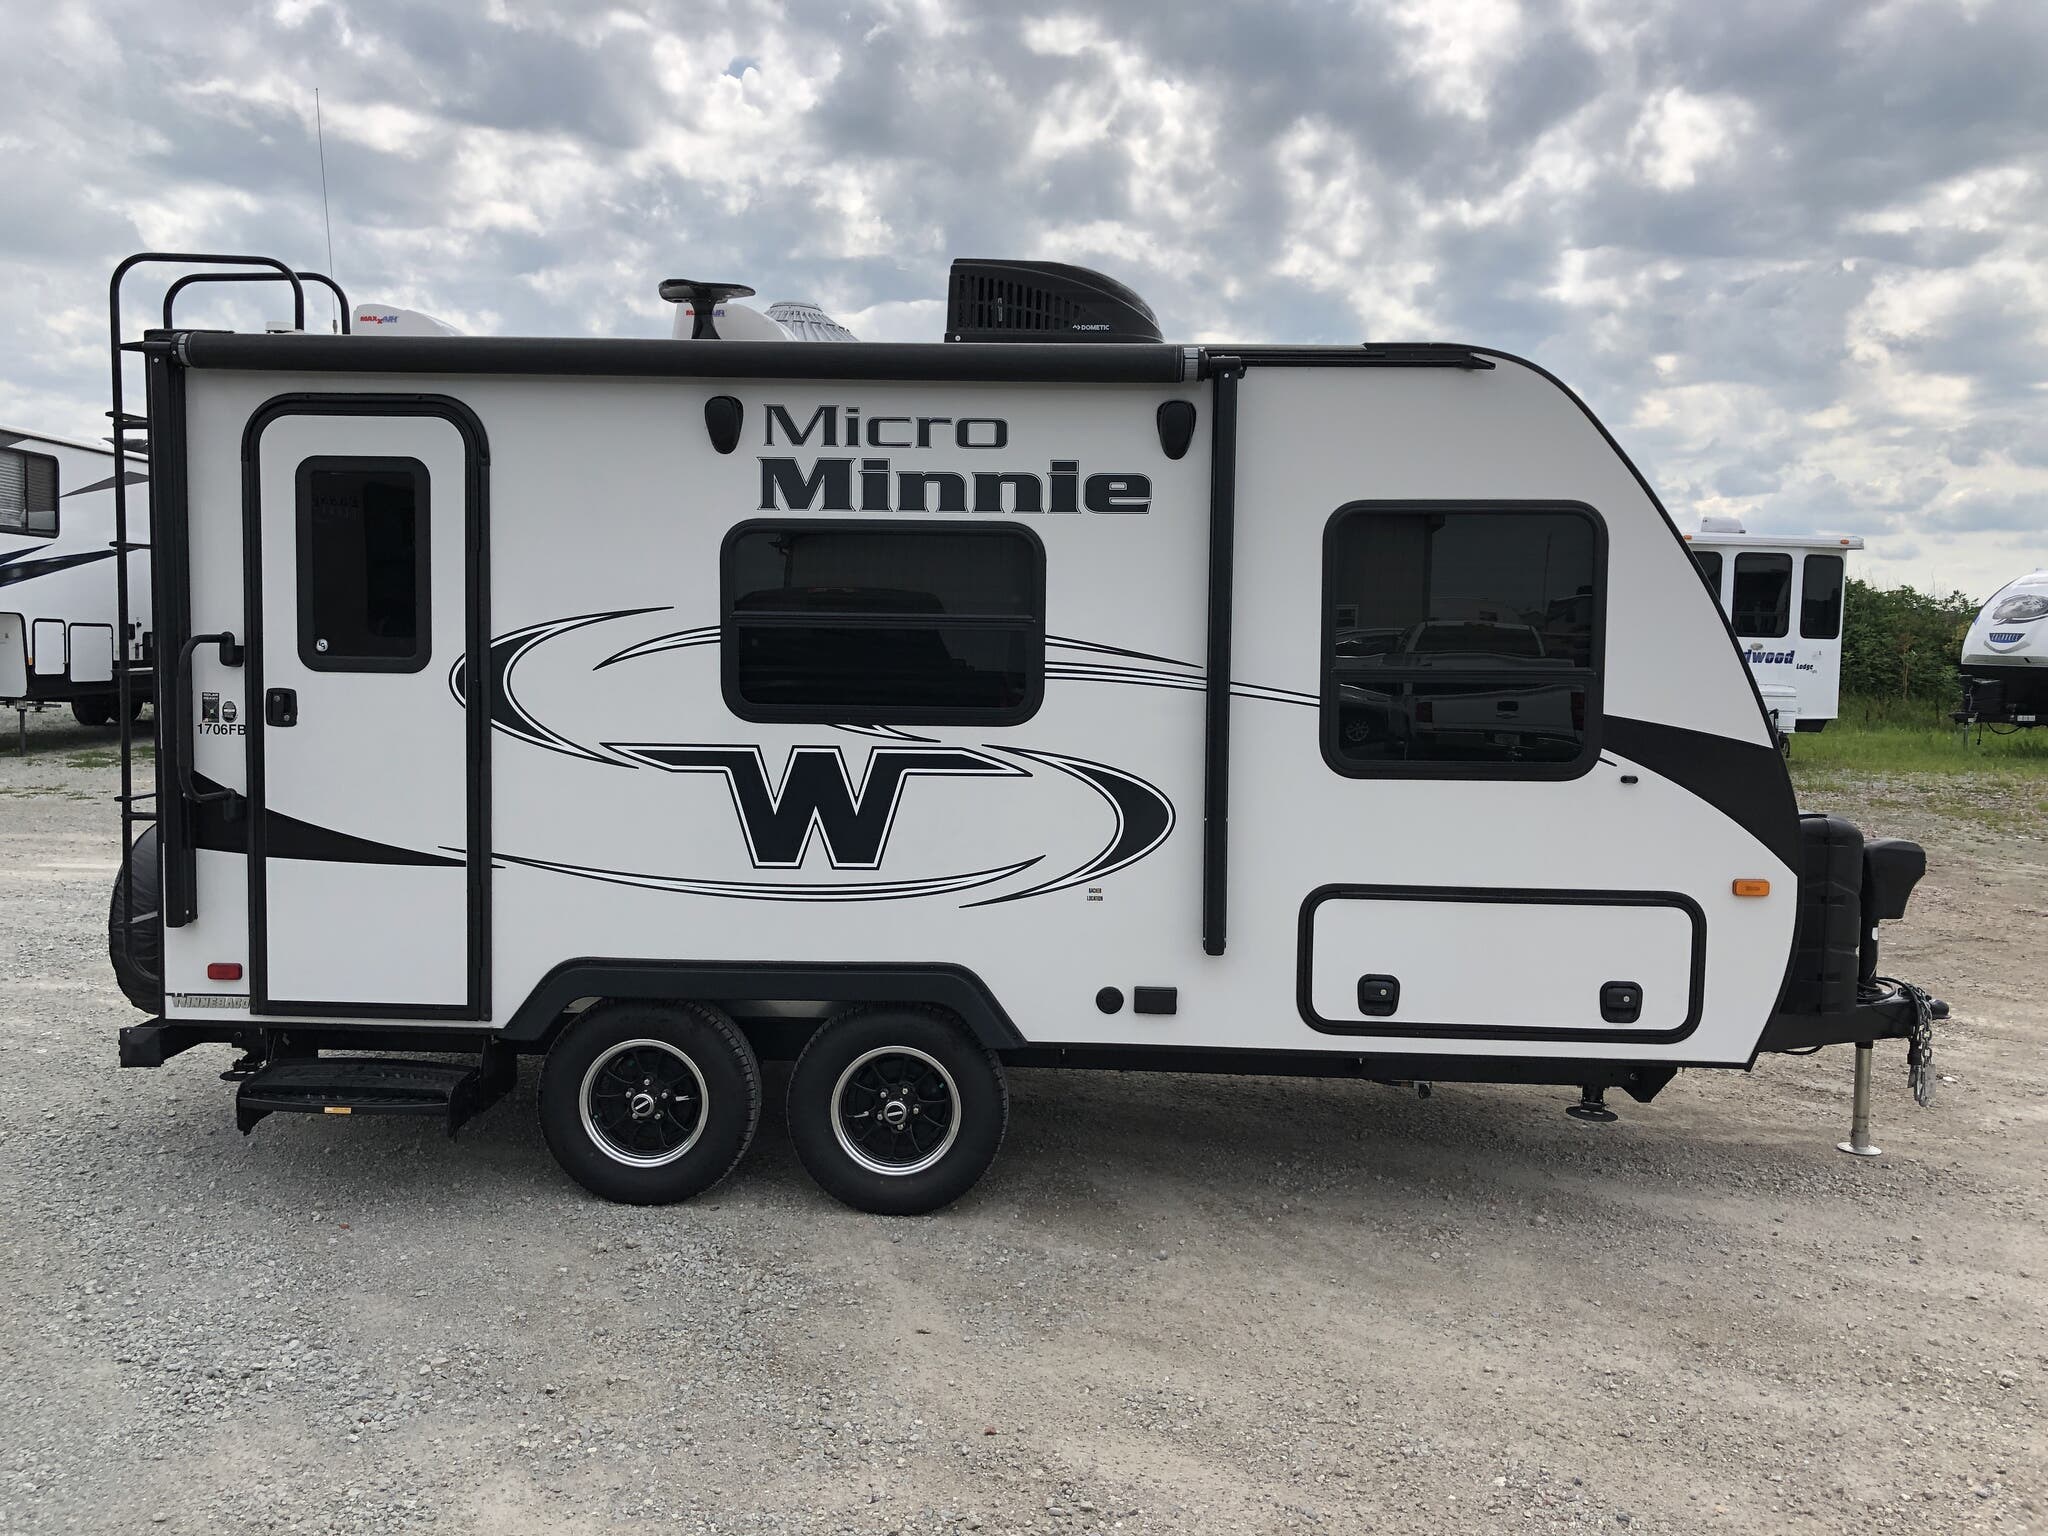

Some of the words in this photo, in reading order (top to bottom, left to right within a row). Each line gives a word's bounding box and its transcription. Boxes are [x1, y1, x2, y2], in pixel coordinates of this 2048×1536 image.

[763, 404, 1009, 449] Micro
[757, 456, 1152, 515] Minnie
[1743, 649, 1795, 664] dwood
[1796, 663, 1814, 671] Lodge
[197, 723, 247, 735] 1706FB
[725, 744, 907, 870] W
[172, 993, 250, 1008] WINNEBAGO
